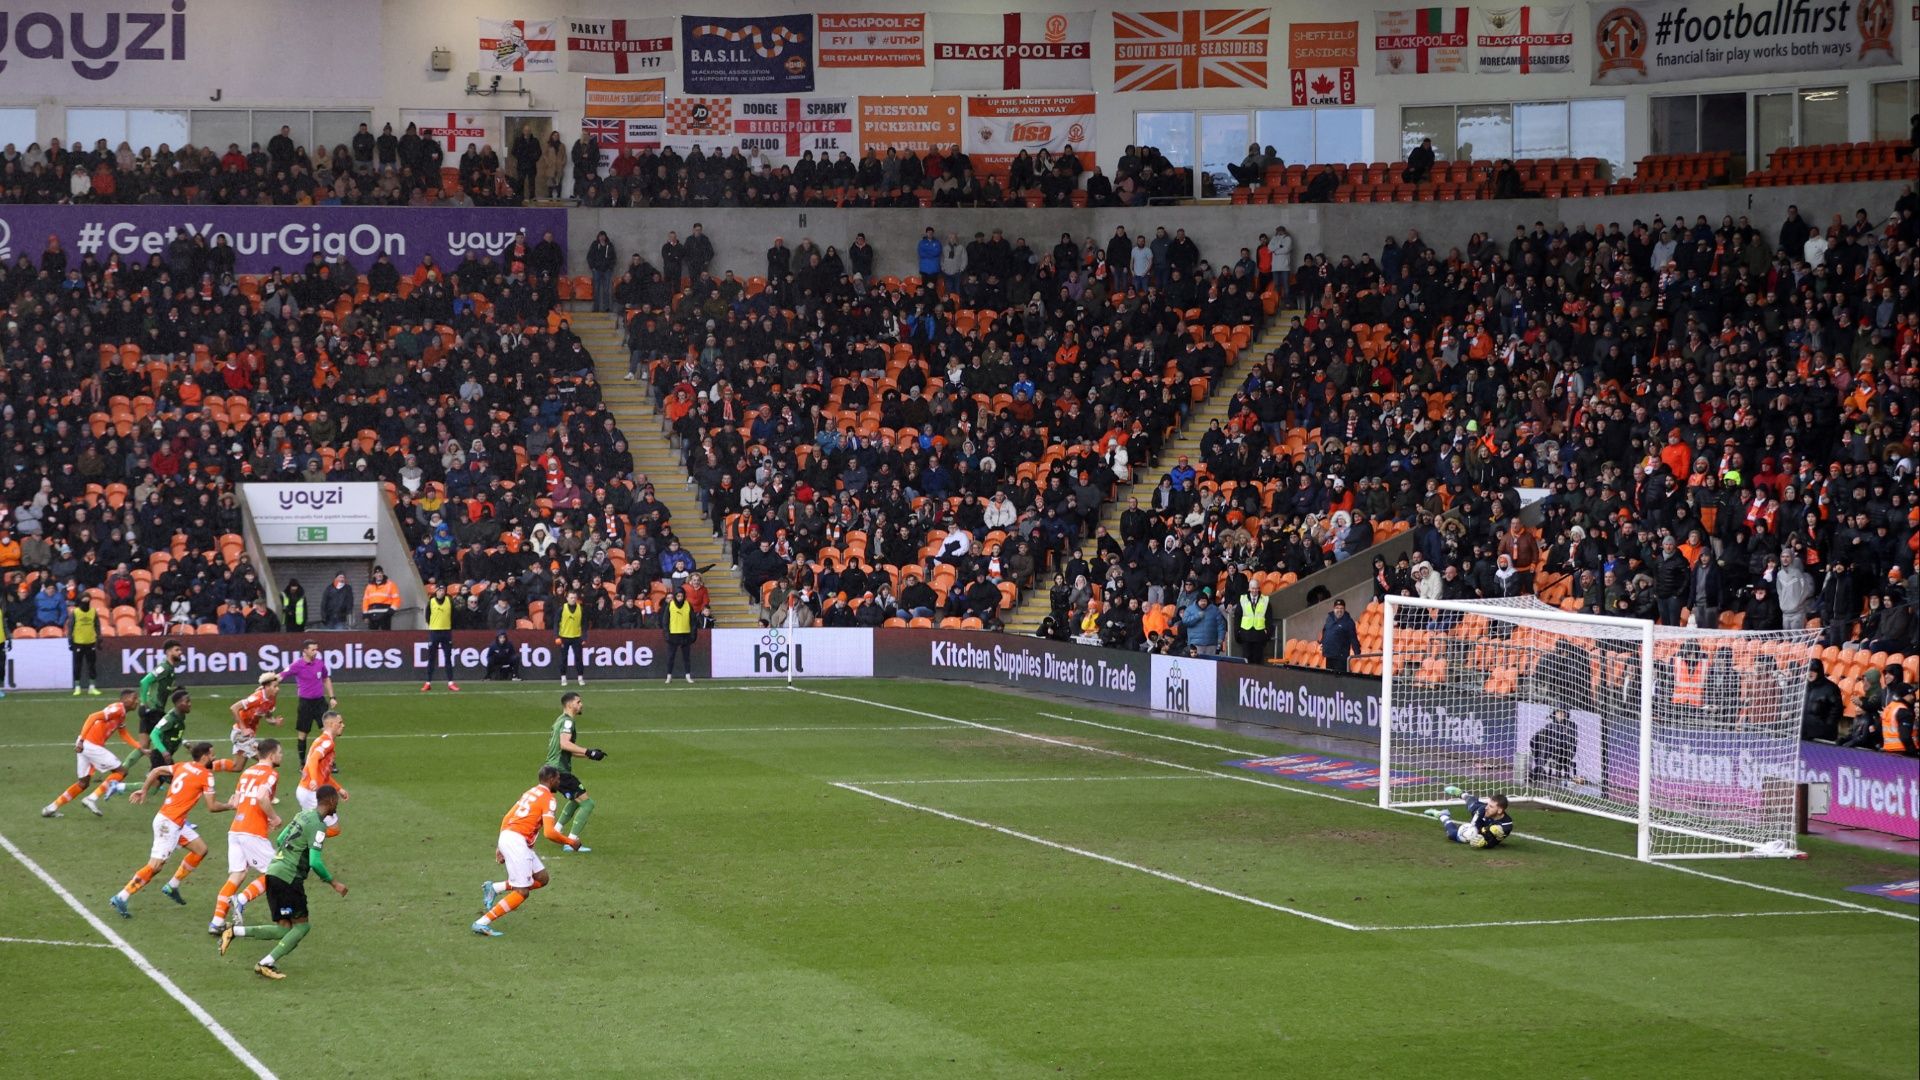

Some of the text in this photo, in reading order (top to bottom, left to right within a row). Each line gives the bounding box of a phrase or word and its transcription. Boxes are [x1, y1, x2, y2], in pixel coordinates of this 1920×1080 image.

[571, 23, 605, 34] PARKY
[822, 18, 920, 28] BLACKPOOL FC
[1655, 0, 1850, 45] #footballfirst
[0, 0, 186, 80] ayzi
[1294, 30, 1355, 41] SHEFFIELD
[1378, 35, 1464, 48] BLACKPOOL FC
[1479, 35, 1570, 45] BLACKPOOL FC
[580, 40, 663, 51] BLACKPOOL FC
[942, 45, 1083, 58] BLACKPOOL FC
[1119, 41, 1264, 58] SOUTH SHORE SEASIDERS
[691, 49, 751, 62] B.A.S.I.L.
[1295, 47, 1356, 58] SEASIDERS
[1656, 42, 1852, 66] financial fair play works both ways
[642, 57, 660, 67] FY7
[1528, 55, 1570, 64] SEASIDERS
[1294, 71, 1304, 103] AMY
[1343, 72, 1352, 100] JOE
[210, 89, 222, 102] J
[1310, 97, 1339, 105] CLARKE
[694, 108, 707, 117] JD
[743, 103, 778, 114] DODGE
[807, 103, 847, 114] SPARKY
[864, 105, 956, 115] PRESTON 0
[422, 128, 469, 136] ACKPOOL
[750, 121, 836, 132] BLACKPOOL FC
[864, 121, 956, 132] PICKERING 3
[891, 141, 929, 151] APRIL
[799, 214, 807, 228] H
[77, 222, 405, 263] #GetYourGigOn
[279, 486, 343, 510] yayzi
[363, 527, 375, 541] 4
[259, 643, 403, 675] Suplies
[414, 642, 492, 667] Direc
[519, 642, 552, 666] to
[754, 644, 804, 673] hdl
[931, 640, 1136, 692] Kitchen Supplies Direct to Trade
[1166, 677, 1190, 712] hdl
[1239, 677, 1484, 745] Kitchen Supplies Diect to Trade
[171, 772, 188, 795] 6
[1652, 744, 1732, 785] itchen
[1837, 766, 1906, 816] Direct
